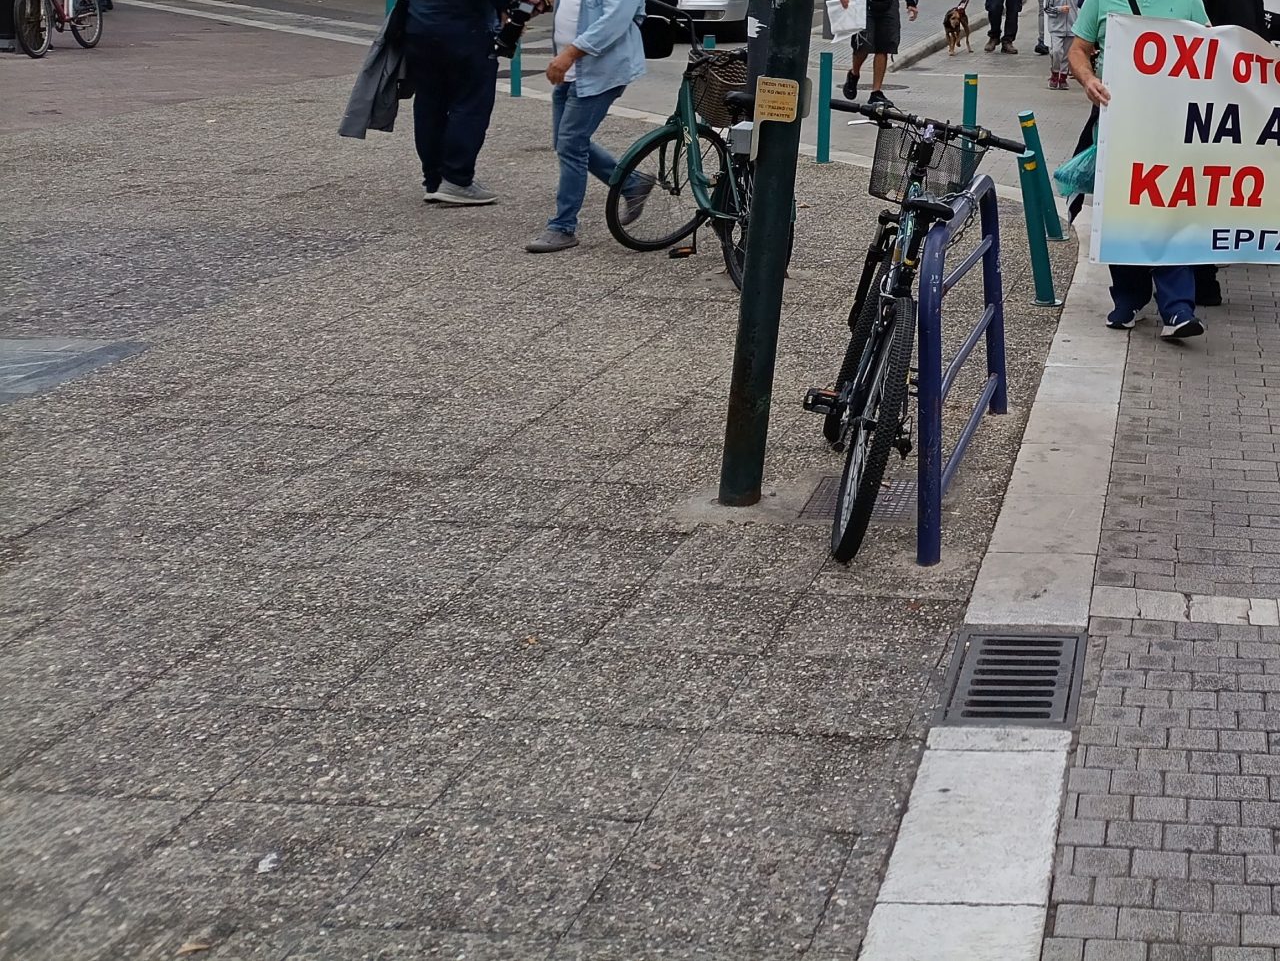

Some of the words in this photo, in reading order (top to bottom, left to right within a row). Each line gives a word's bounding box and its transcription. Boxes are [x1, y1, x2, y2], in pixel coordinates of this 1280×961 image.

[1132, 31, 1220, 80] ΟΧΙ
[1183, 102, 1242, 144] ΝΑ
[1128, 162, 1265, 208] ΚΑΤΩ
